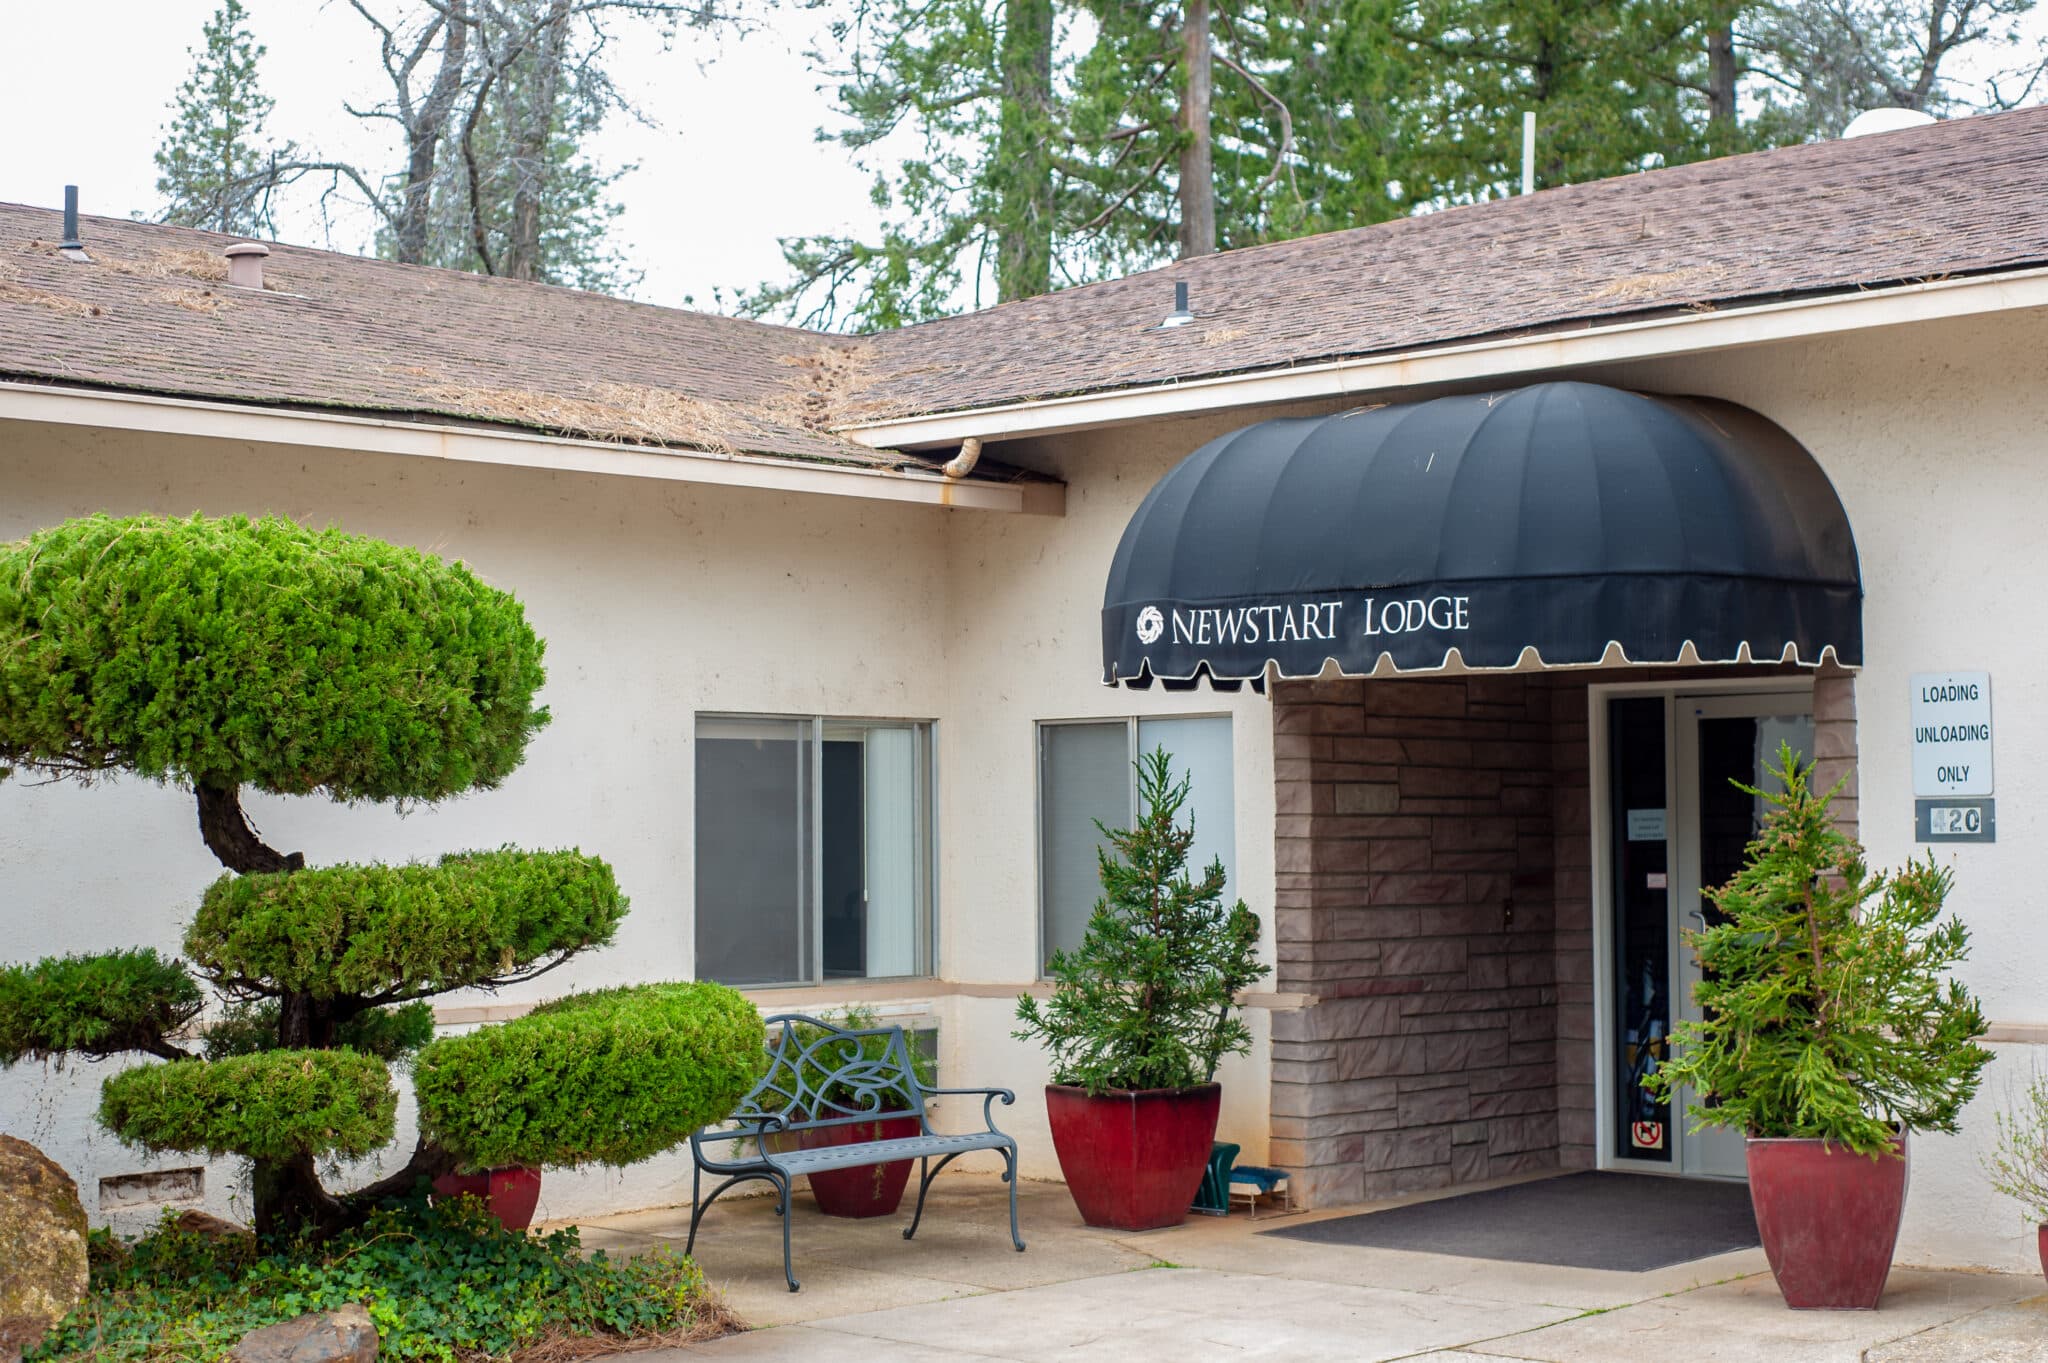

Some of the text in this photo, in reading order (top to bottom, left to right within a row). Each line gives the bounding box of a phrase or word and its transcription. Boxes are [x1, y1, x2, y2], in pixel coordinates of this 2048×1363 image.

[1172, 597, 1470, 645] NEWSTART LODGE
[1922, 684, 1979, 703] LOADING
[1915, 724, 1989, 743] UNLOADING
[1937, 765, 1970, 783] ONLY
